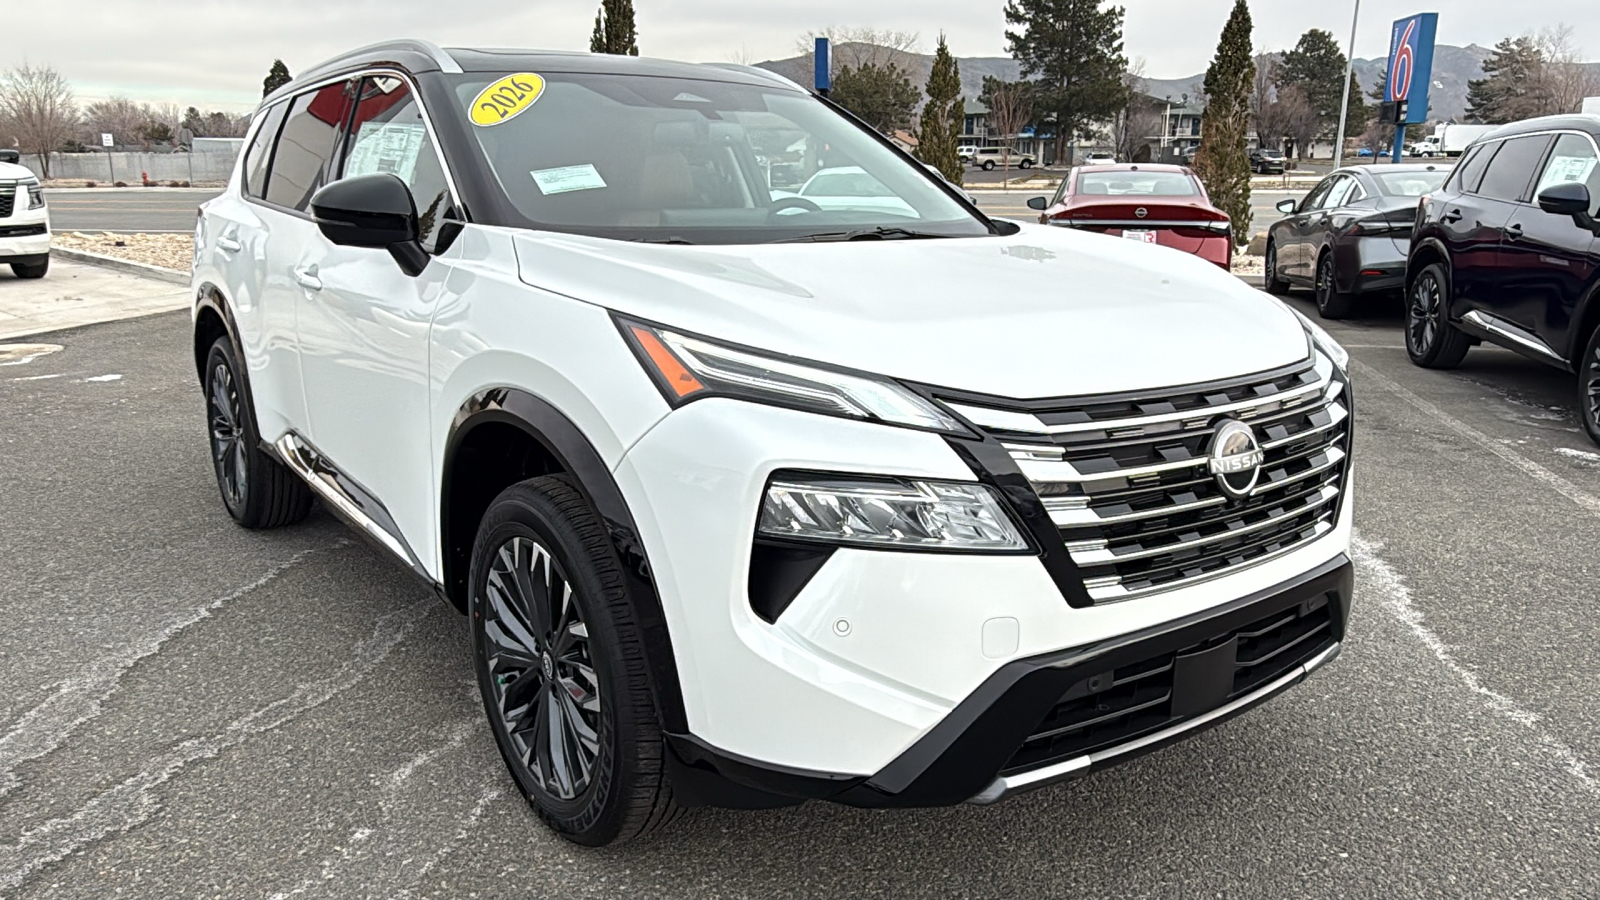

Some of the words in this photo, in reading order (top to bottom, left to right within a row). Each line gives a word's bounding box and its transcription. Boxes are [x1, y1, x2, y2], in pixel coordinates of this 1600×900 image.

[1391, 19, 1415, 101] 6
[481, 77, 534, 118] 2026
[1213, 451, 1264, 473] NISSAN
